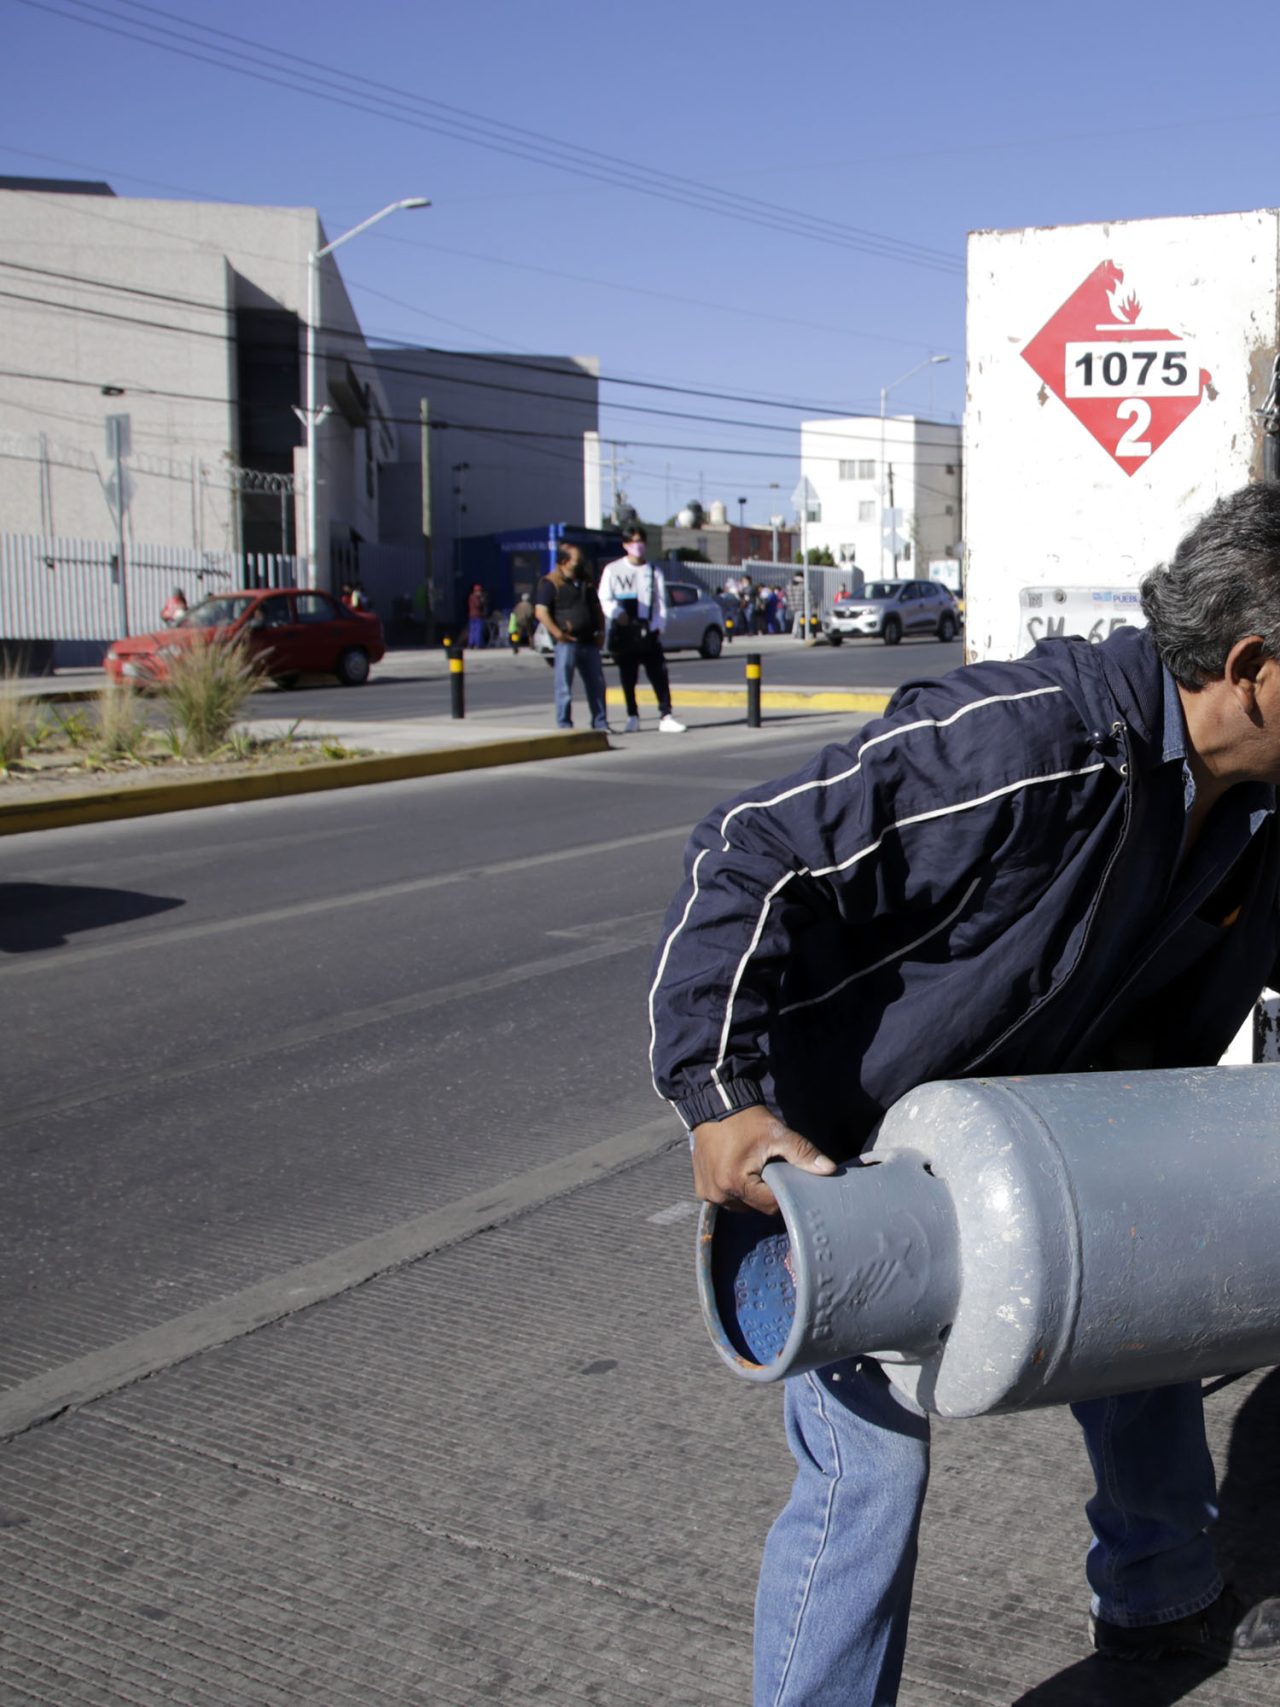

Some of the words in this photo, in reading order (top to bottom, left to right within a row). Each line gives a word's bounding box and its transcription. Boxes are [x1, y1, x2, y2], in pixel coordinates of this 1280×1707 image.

[1075, 351, 1187, 387] 1075
[1115, 397, 1152, 457] 2
[616, 574, 635, 589] W
